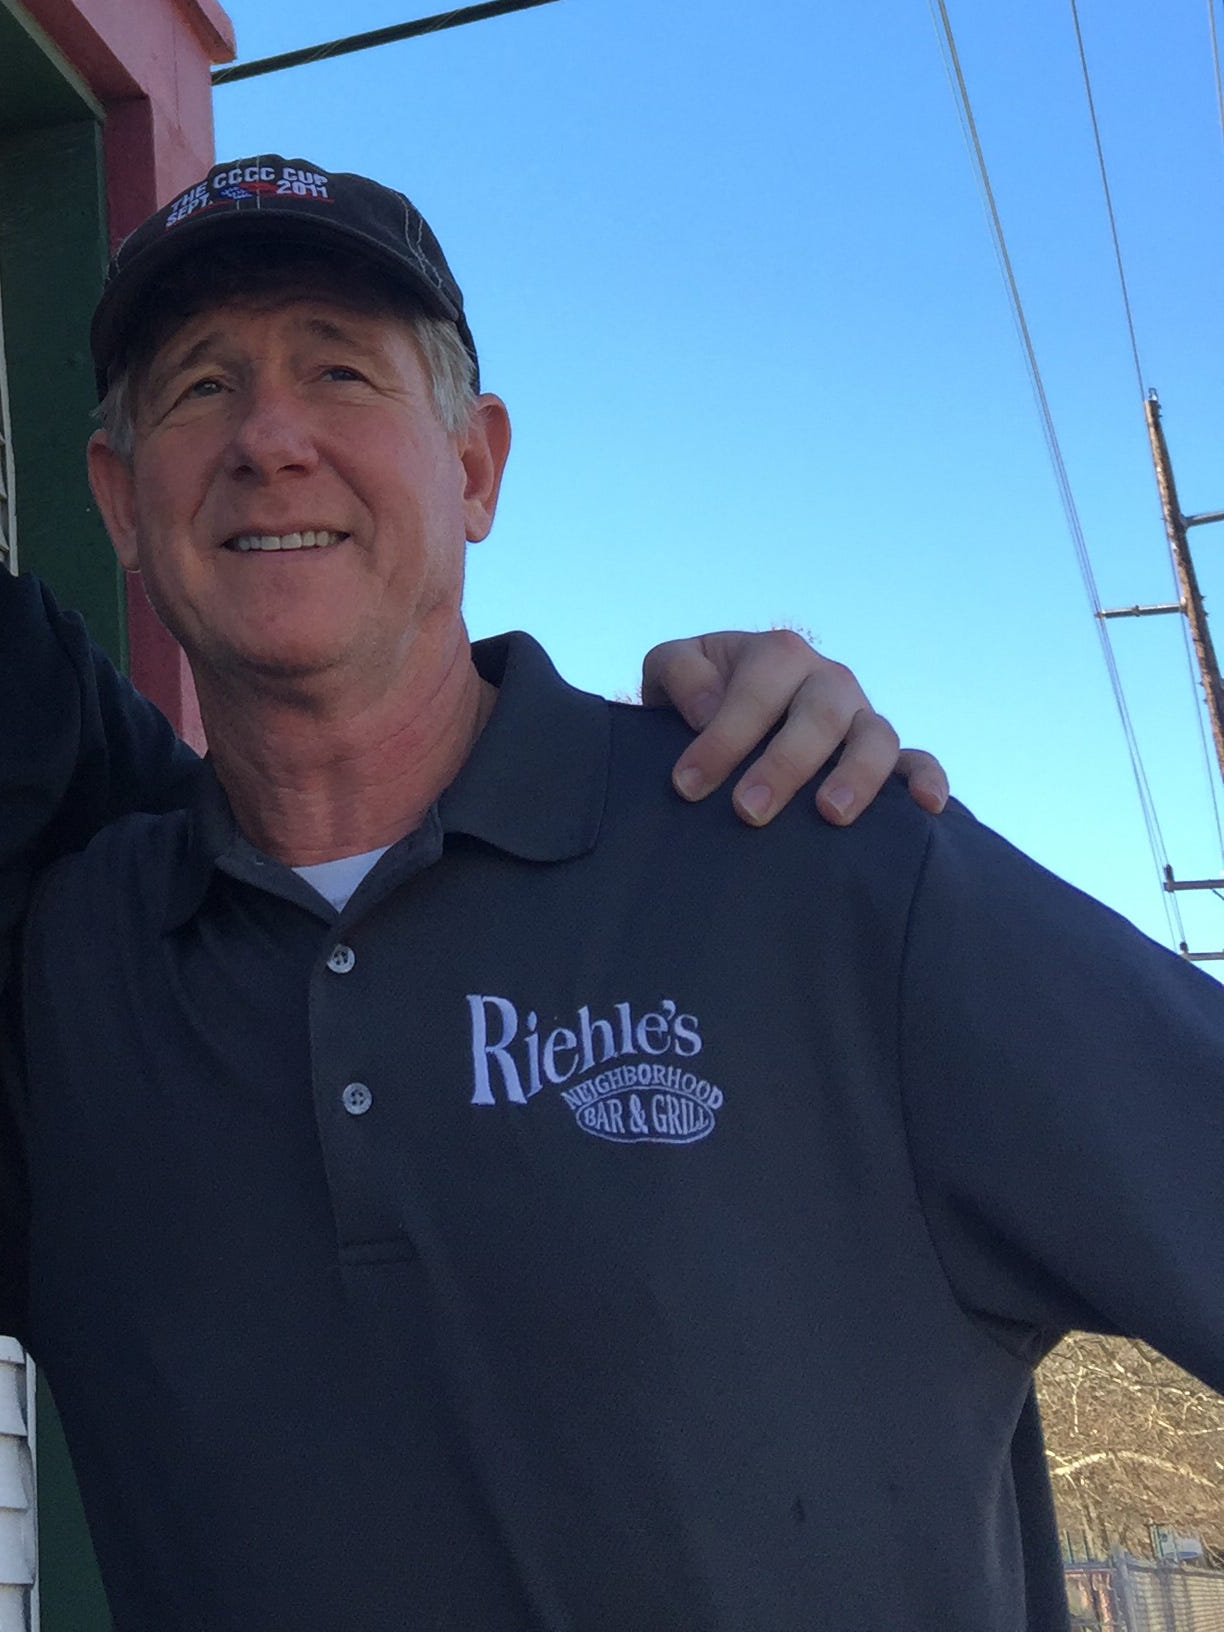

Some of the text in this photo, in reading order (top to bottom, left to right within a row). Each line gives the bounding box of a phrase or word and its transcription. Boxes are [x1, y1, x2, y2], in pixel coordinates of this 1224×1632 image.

[170, 180, 209, 211] THE
[282, 168, 329, 186] CUP
[276, 179, 329, 198] 2011
[466, 994, 703, 1106] Riehle's
[560, 1063, 725, 1111] NEIGHBORHOOD
[583, 1093, 710, 1136] BAR & GRILL
